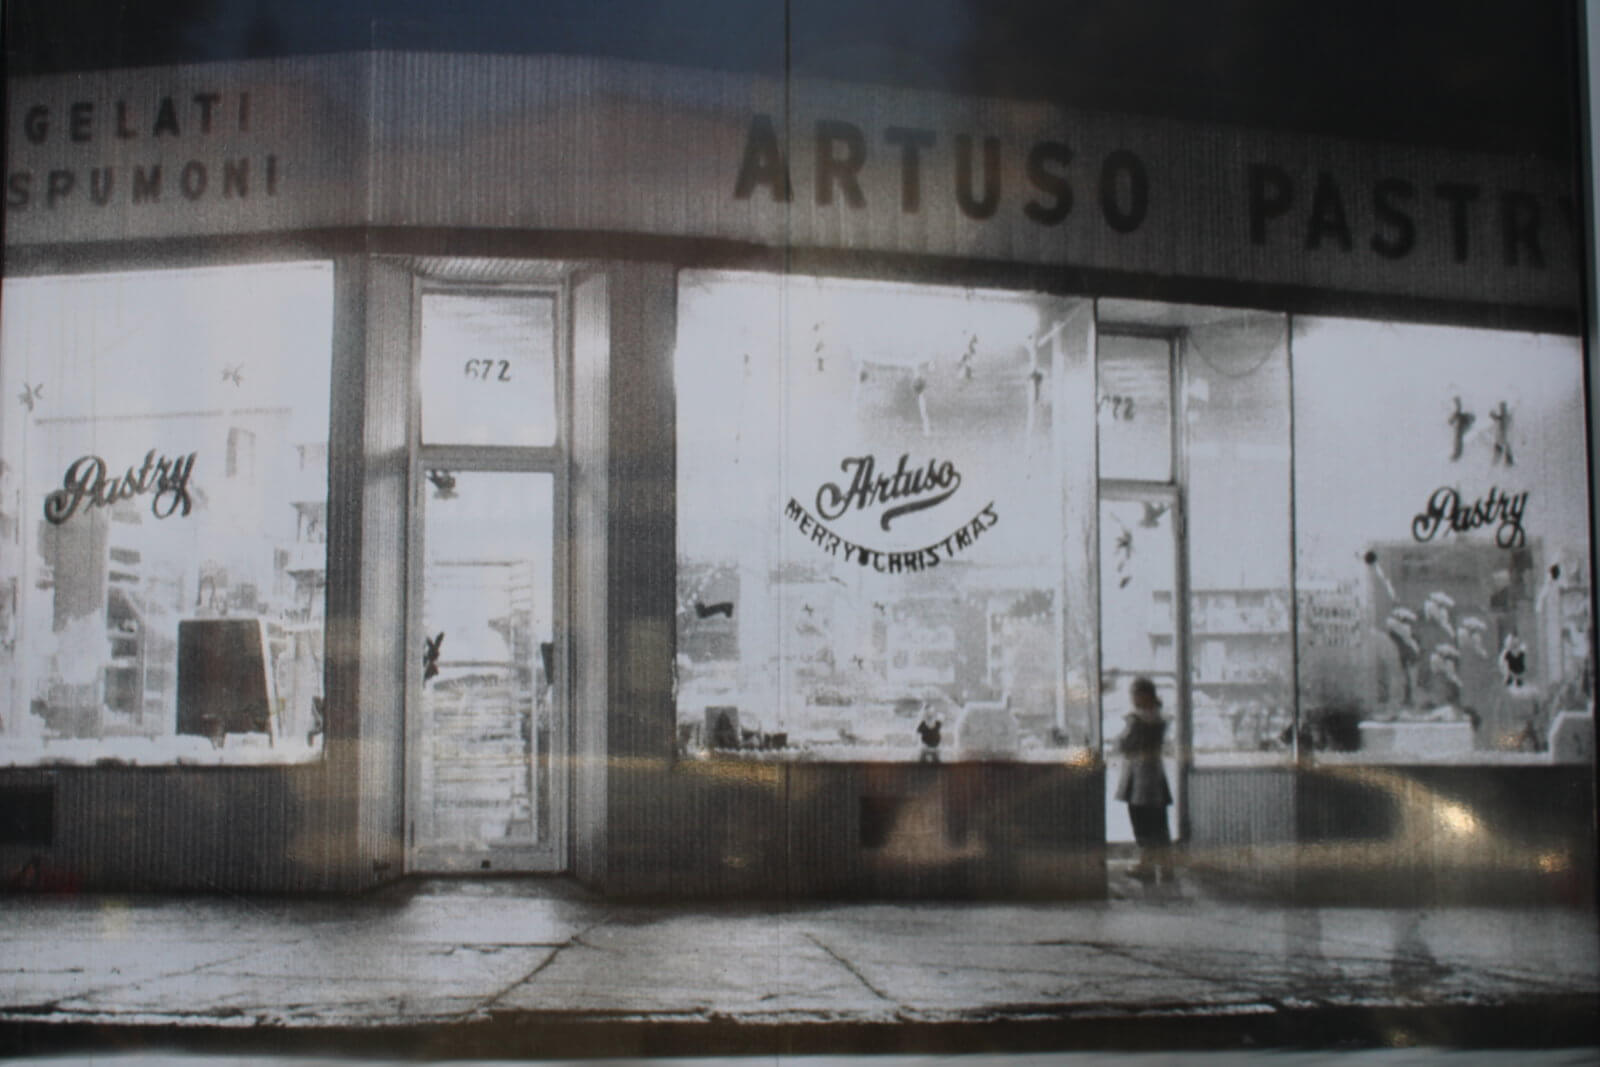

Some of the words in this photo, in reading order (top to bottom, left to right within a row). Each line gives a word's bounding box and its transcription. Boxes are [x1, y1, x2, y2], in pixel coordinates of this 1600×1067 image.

[24, 92, 250, 145] GELATI
[7, 154, 277, 211] SPUMONI
[734, 113, 1149, 234] ARTUSO
[464, 359, 511, 382] 672
[44, 448, 197, 525] Pastry
[815, 453, 962, 532] Artuso
[1411, 485, 1529, 549] Pastry
[785, 496, 857, 562] MERRY
[873, 501, 999, 574] CHRISTMAS
